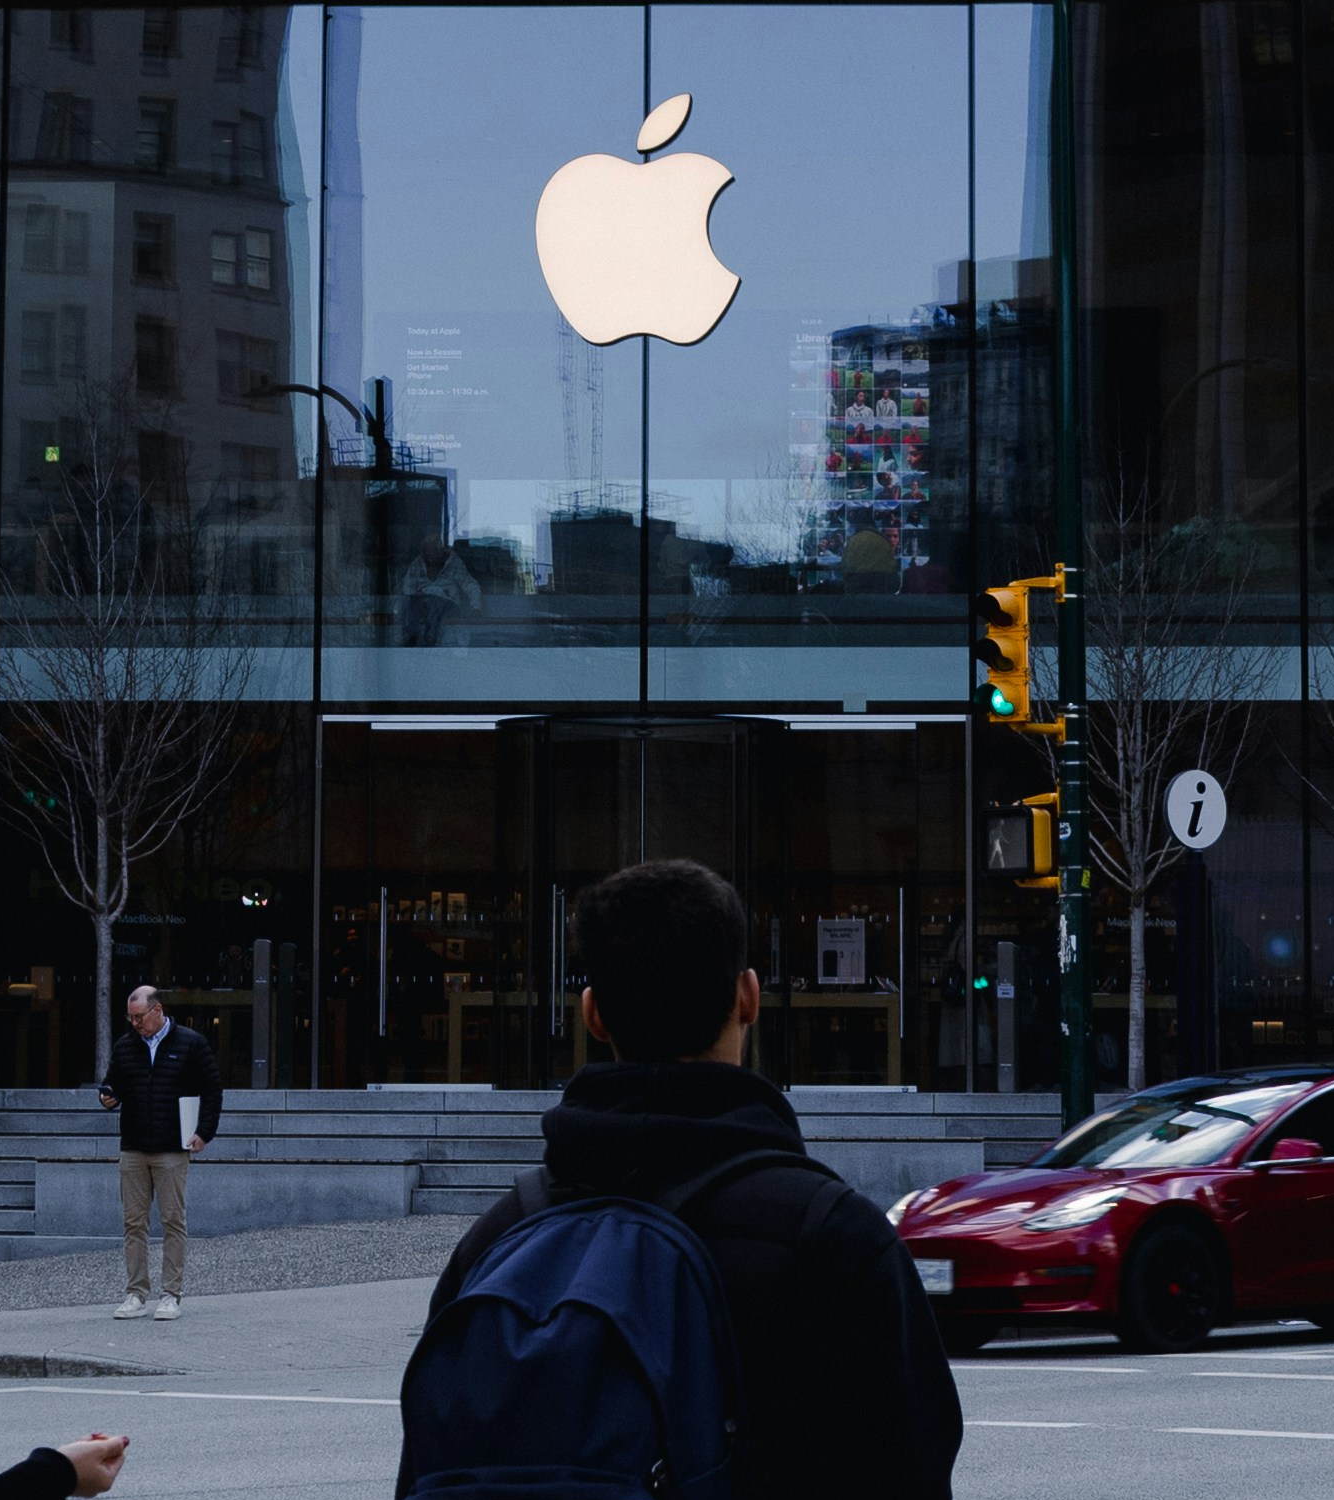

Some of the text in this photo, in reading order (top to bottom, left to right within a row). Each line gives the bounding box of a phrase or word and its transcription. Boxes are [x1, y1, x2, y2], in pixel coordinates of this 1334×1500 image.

[407, 327, 429, 336] Today
[439, 327, 461, 336] Apple
[796, 333, 832, 344] Library
[406, 348, 462, 356] Now in Session
[406, 363, 449, 371] Get Started
[406, 372, 432, 380] iPhone
[118, 914, 186, 924] MacBook Neo
[1107, 917, 1177, 927] Macok Neo
[115, 943, 147, 957] SECURITY
